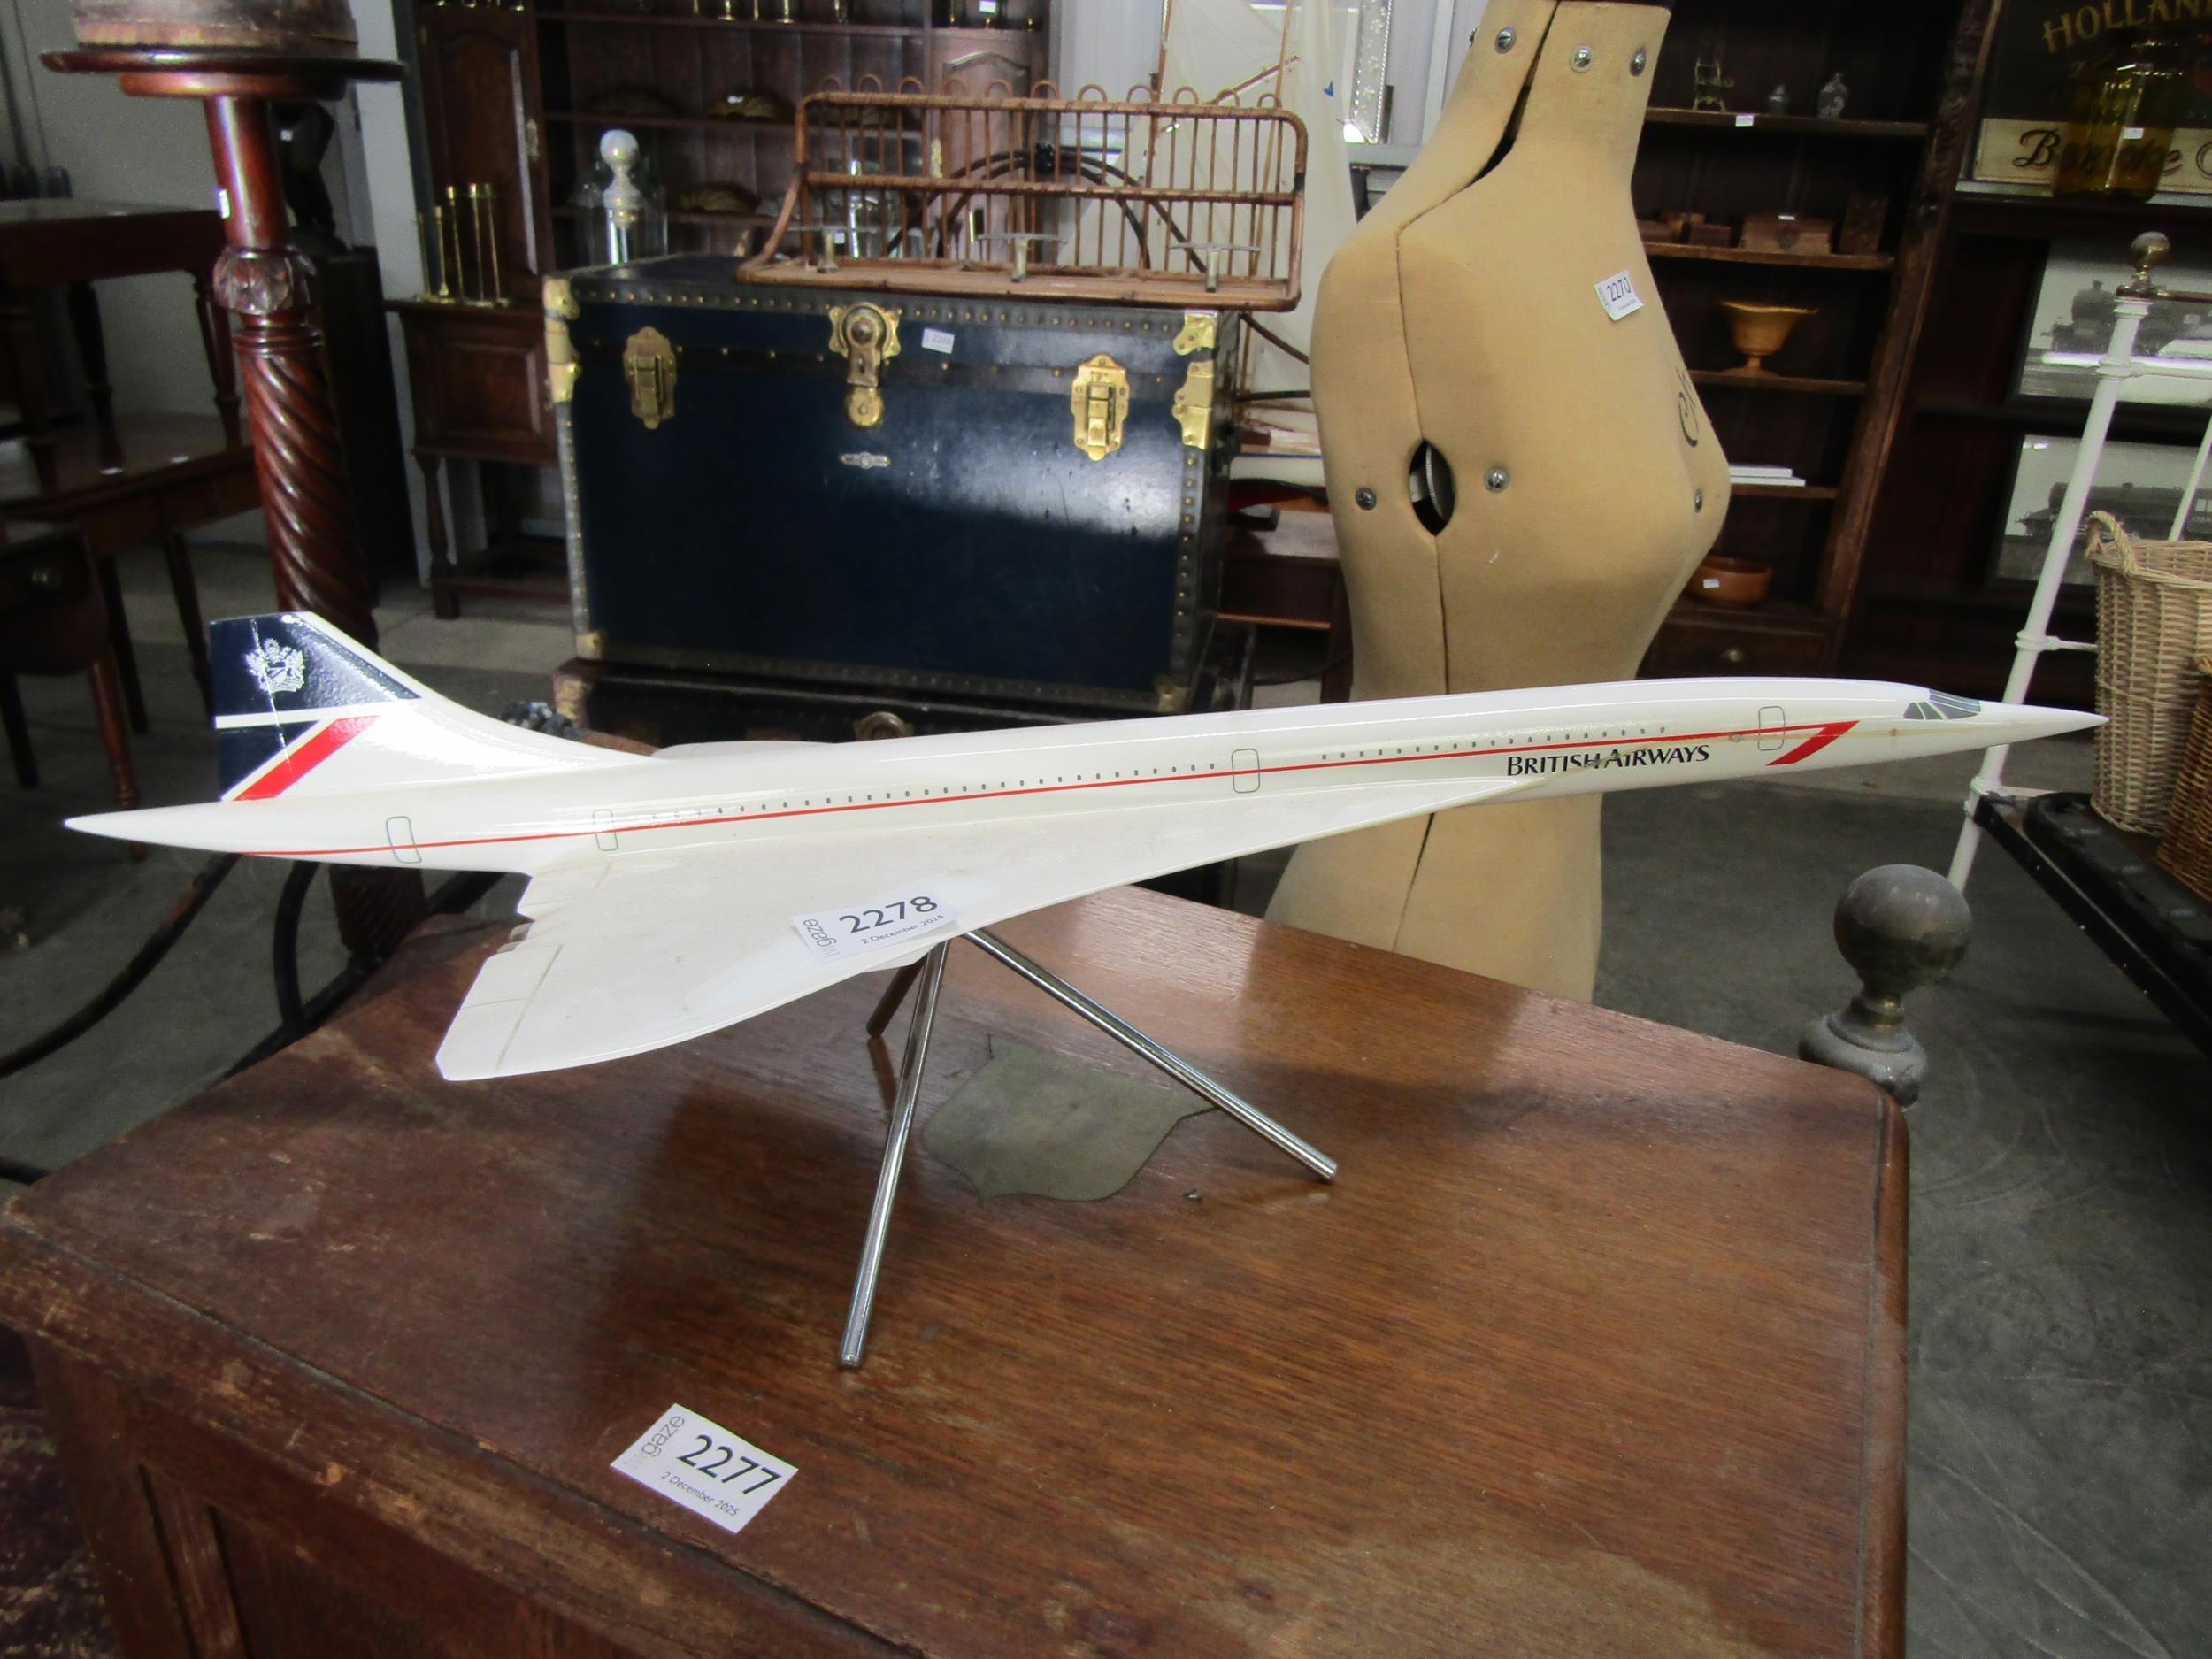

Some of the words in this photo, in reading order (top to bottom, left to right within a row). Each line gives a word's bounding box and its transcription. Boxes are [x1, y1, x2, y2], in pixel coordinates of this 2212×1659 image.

[2042, 0, 2212, 54] HOLLAN
[1606, 276, 1632, 302] 2270
[1506, 753, 1601, 777] BRITISH
[1603, 744, 1710, 769] AIRWAYS
[839, 895, 939, 934] 2278
[869, 924, 918, 942] December
[919, 914, 945, 926] 2025
[676, 1433, 782, 1495] 2277
[661, 1471, 672, 1480] 2
[669, 1475, 716, 1503] December
[714, 1499, 741, 1517] 2025
